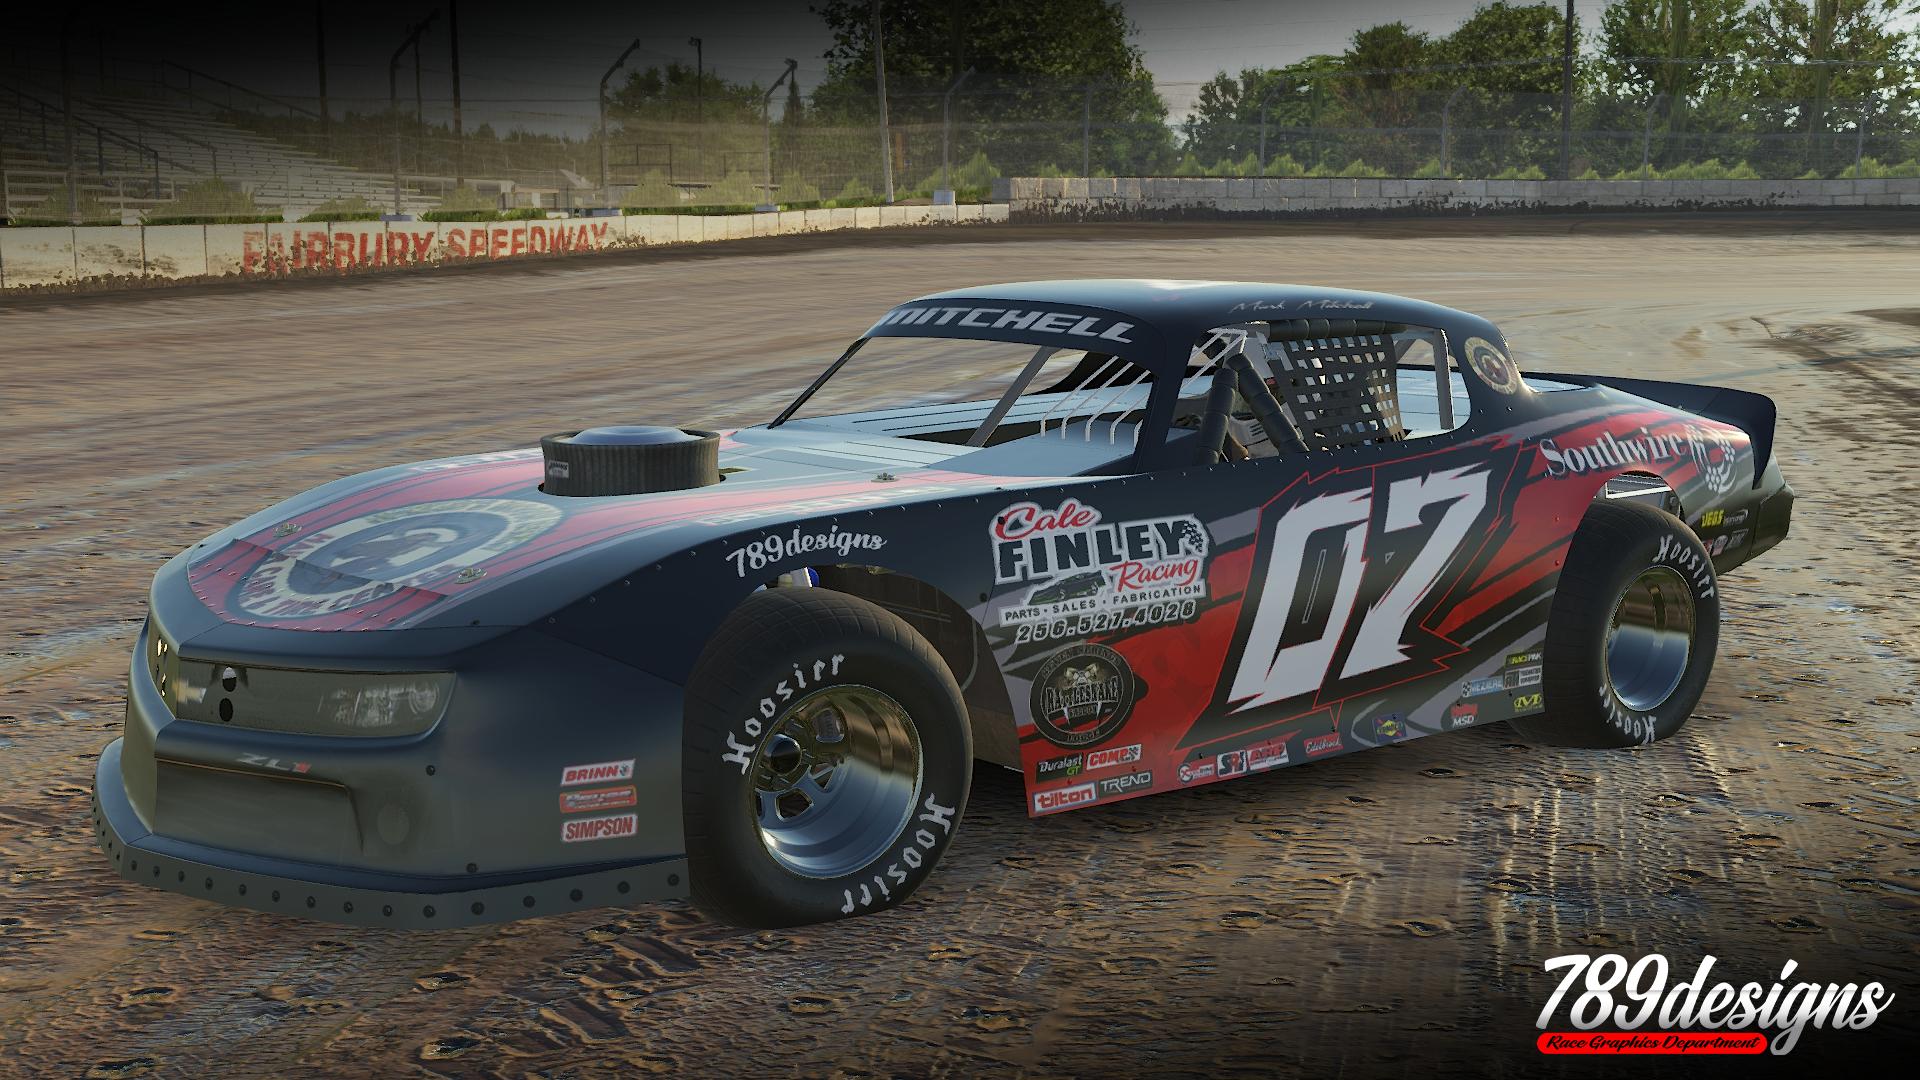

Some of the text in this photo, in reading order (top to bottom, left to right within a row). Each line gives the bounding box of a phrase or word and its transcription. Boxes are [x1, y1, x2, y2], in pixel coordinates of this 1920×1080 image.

[243, 222, 609, 275] FAIRBURY SPEEDWAY
[880, 307, 1135, 344] MITCHELL
[1539, 426, 1688, 477] Southwire
[995, 502, 1096, 541] Cale
[725, 525, 888, 578] 789designs
[998, 519, 1204, 579] FINLEY
[1110, 558, 1199, 593] Racing
[1225, 460, 1493, 716] 07
[1005, 584, 1201, 622] PARTS SALES FABRICATION
[1016, 600, 1197, 644] 256.527.4028
[1453, 715, 1475, 729] MSD
[1039, 753, 1083, 773] Duralast
[1305, 736, 1342, 754] Edelbrock
[565, 764, 619, 782] BRINN
[1100, 772, 1151, 793] TREND
[1038, 788, 1093, 809] tilton
[566, 816, 633, 840] SIMPSON
